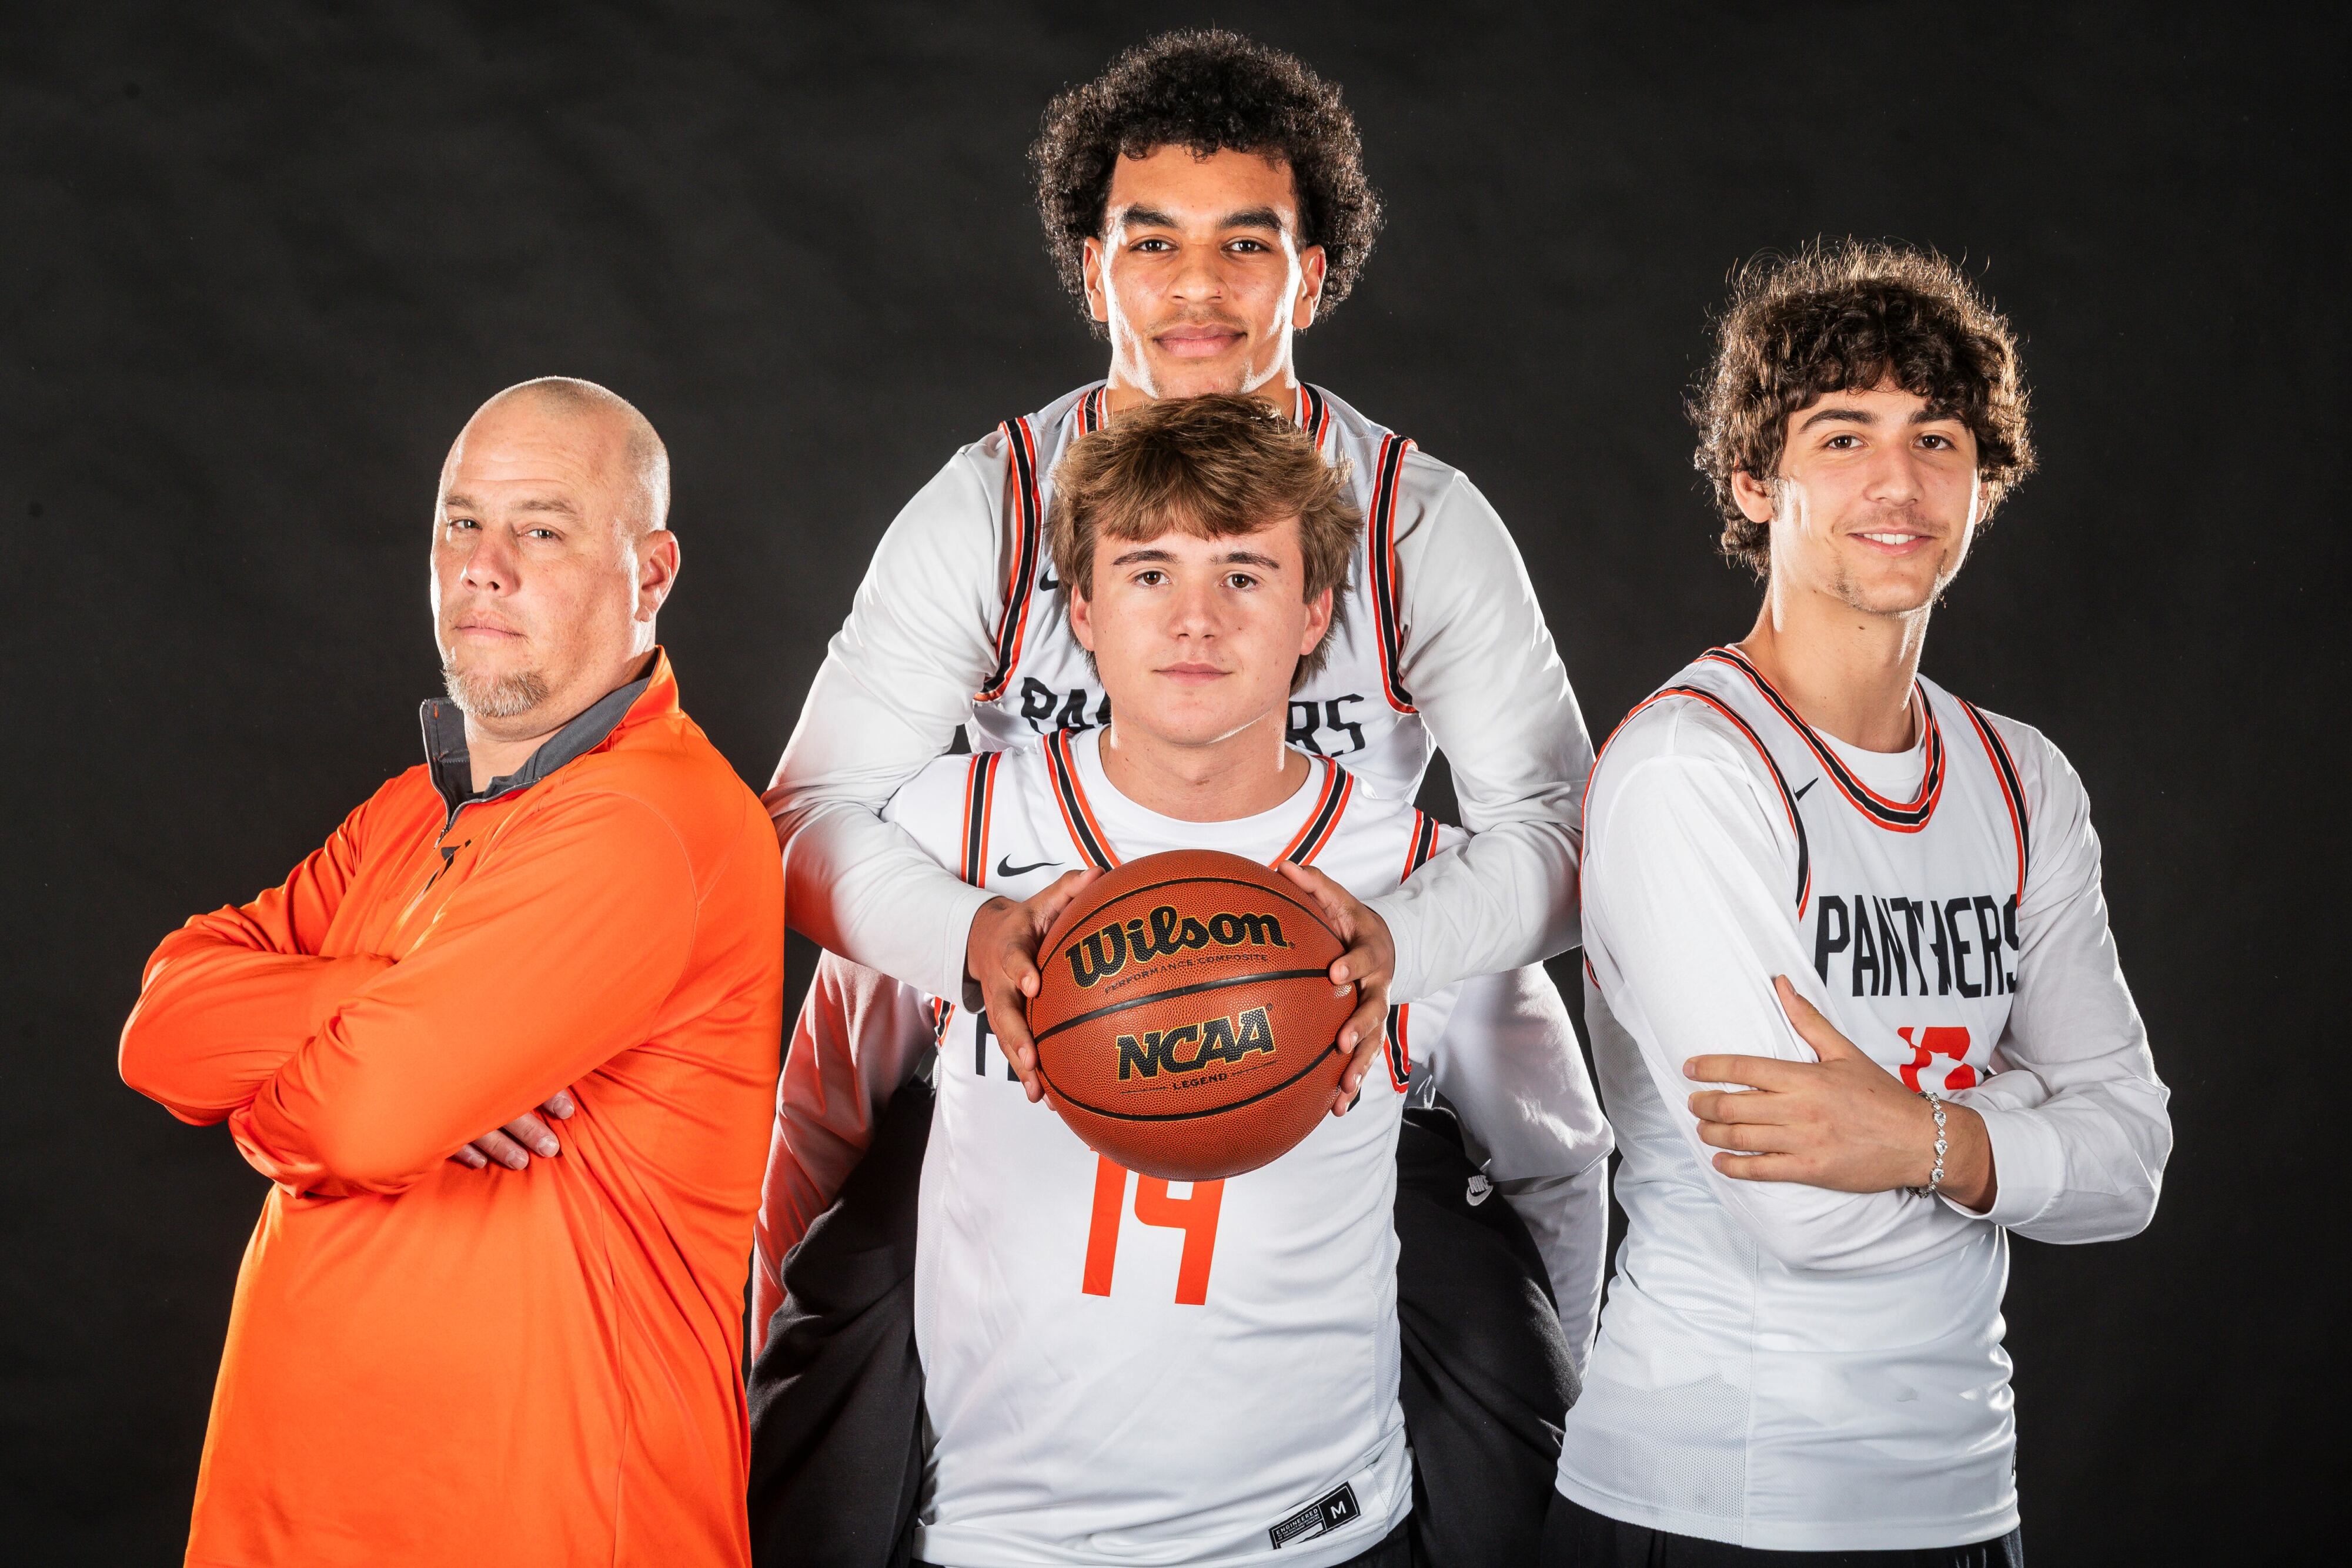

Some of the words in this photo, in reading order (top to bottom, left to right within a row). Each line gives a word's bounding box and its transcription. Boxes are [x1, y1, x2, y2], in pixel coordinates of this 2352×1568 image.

[1020, 677, 1366, 758] PARS
[1065, 905, 1289, 988] Wilson
[1104, 959, 1194, 994] PERFORMANCE
[1198, 954, 1268, 964] COMPOSITE
[1814, 893, 2019, 998] PANTHERS
[1115, 1005, 1277, 1081] NCAA
[1172, 1073, 1227, 1090] LEGEND
[1276, 1508, 1318, 1534] ENGINEERED
[1330, 1500, 1347, 1519] M
